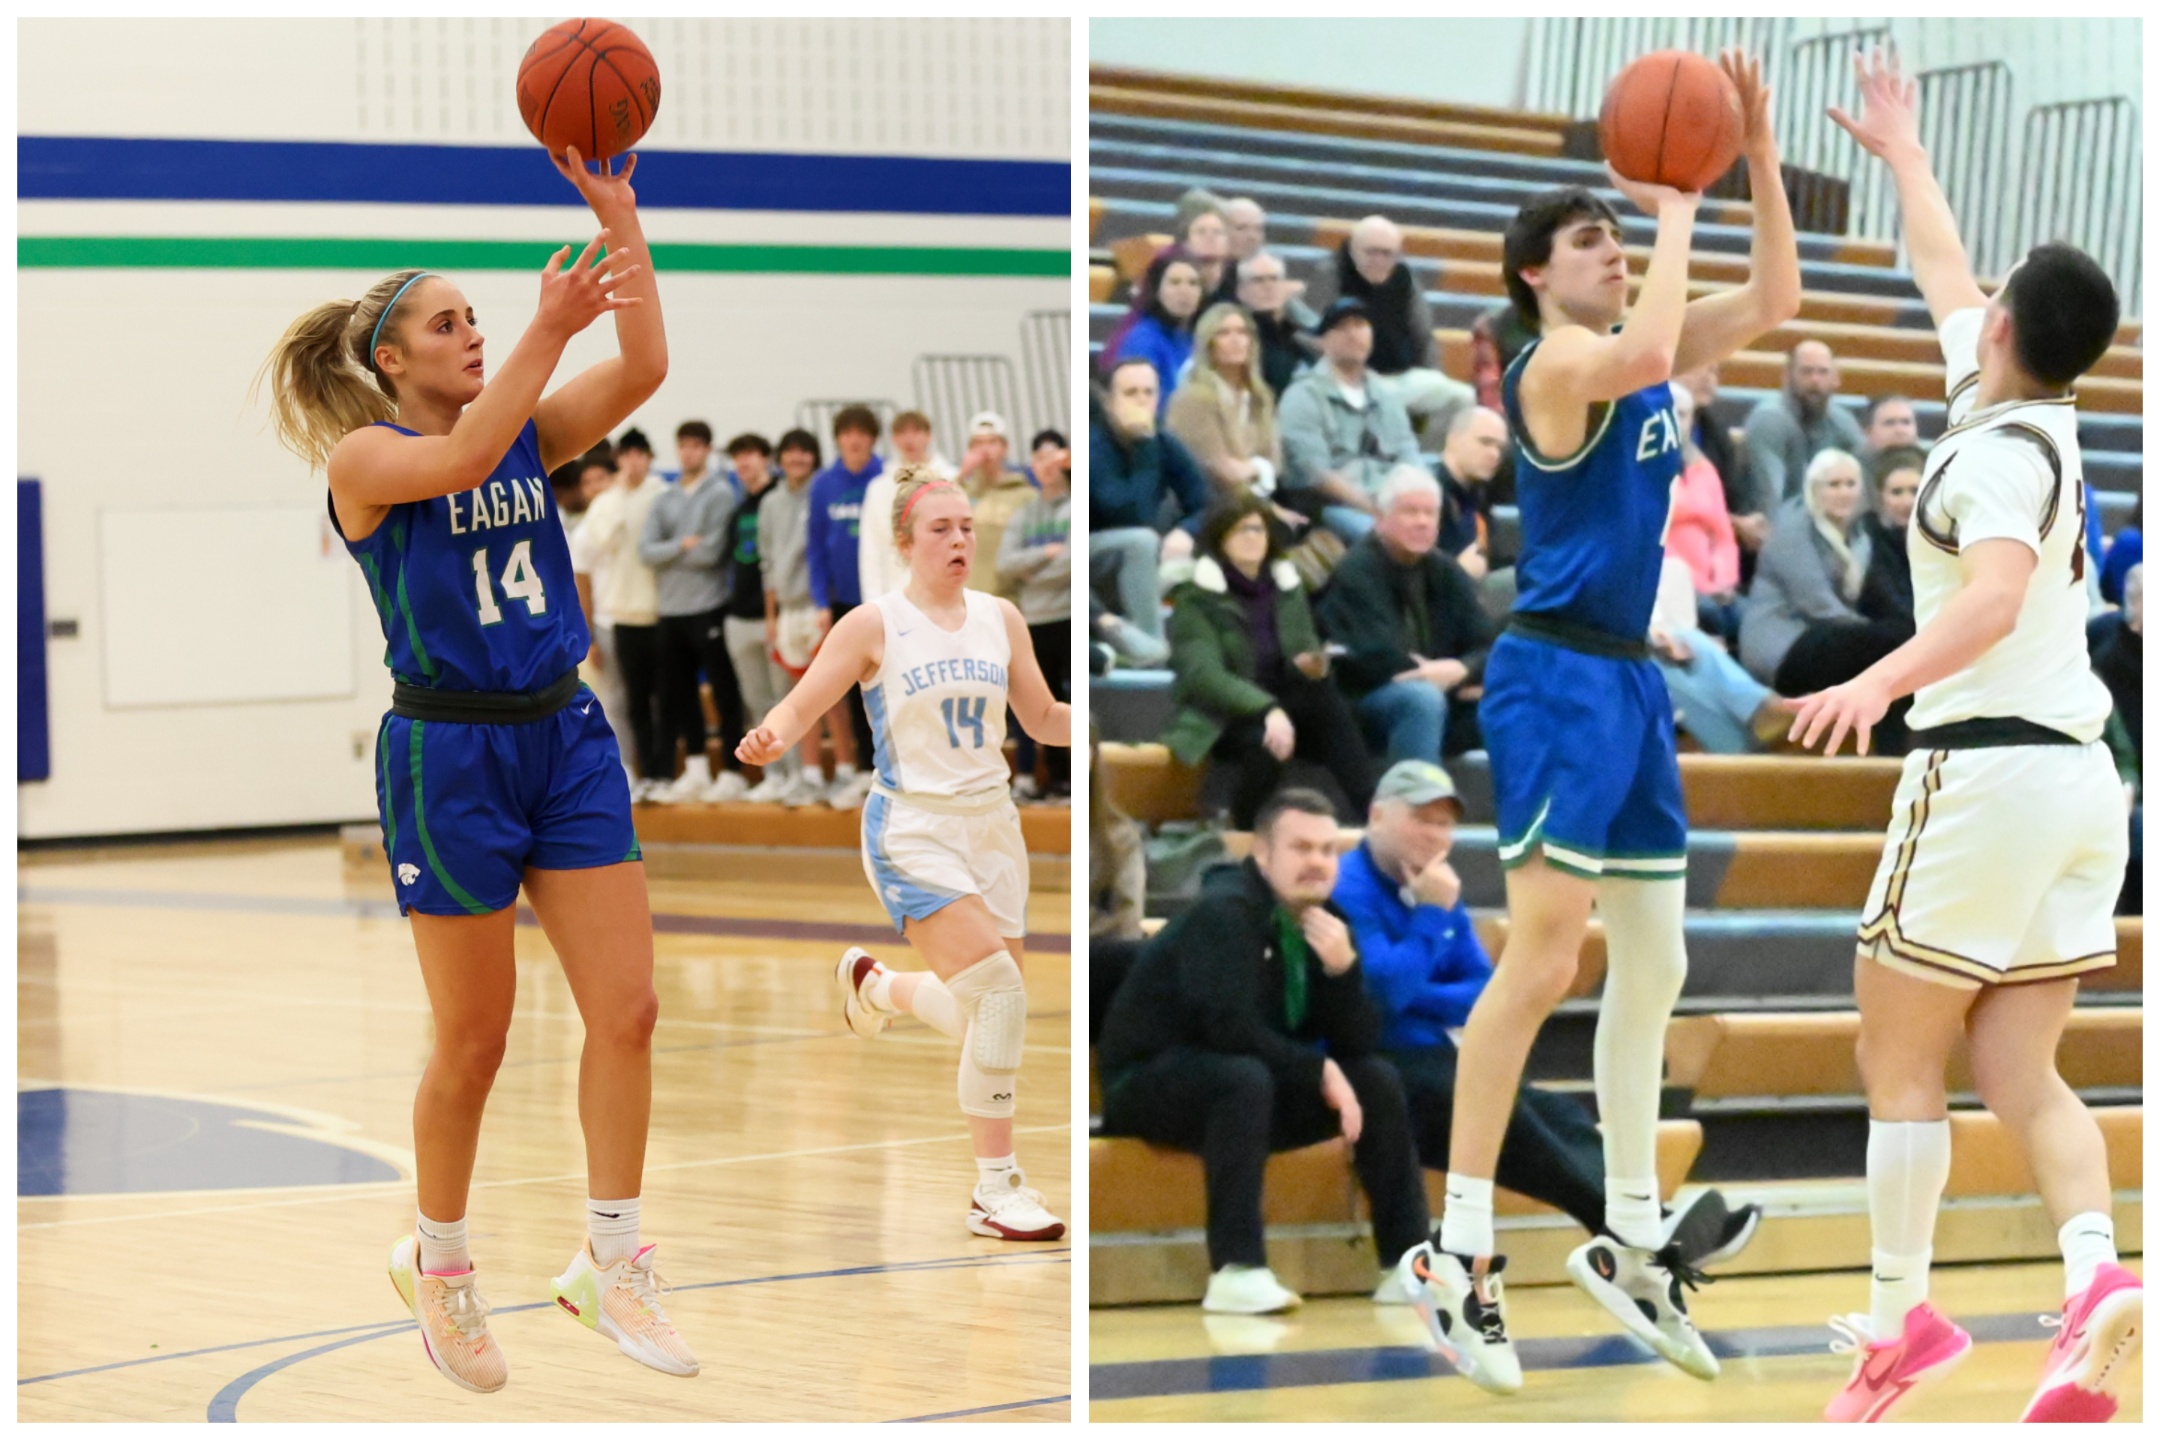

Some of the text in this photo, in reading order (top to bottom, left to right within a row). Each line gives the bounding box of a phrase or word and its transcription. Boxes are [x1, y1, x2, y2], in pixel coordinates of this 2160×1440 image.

[446, 477, 545, 534] EAGAN
[472, 539, 547, 626] 14
[902, 658, 1006, 696] JEFFERSON
[941, 697, 986, 748] 14
